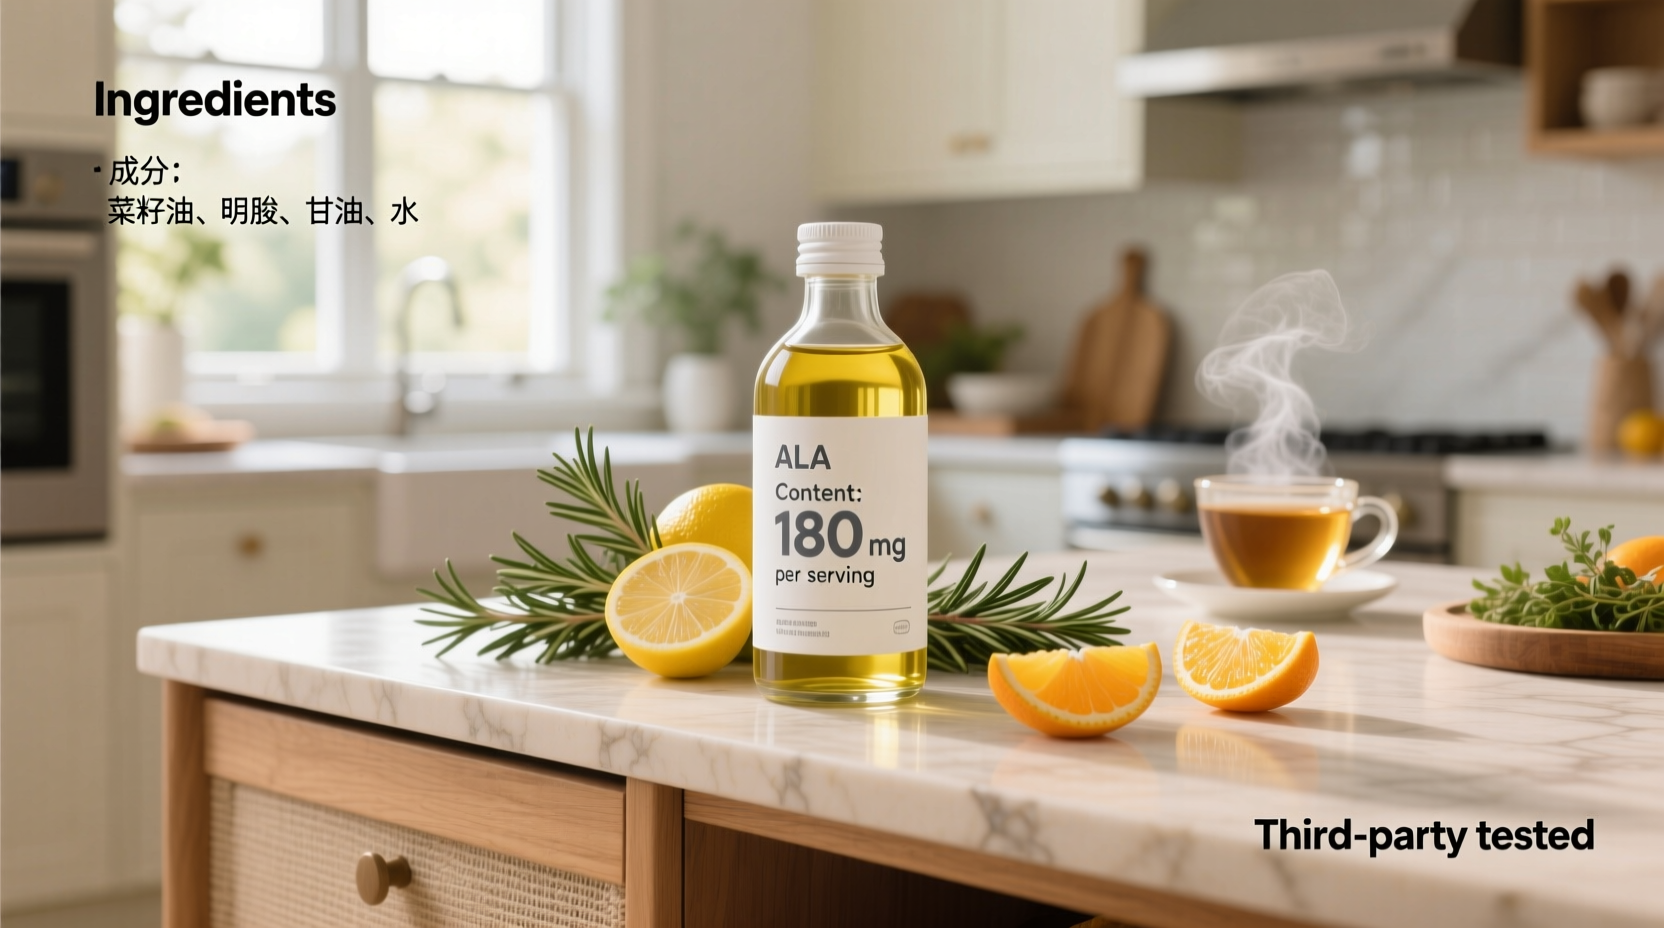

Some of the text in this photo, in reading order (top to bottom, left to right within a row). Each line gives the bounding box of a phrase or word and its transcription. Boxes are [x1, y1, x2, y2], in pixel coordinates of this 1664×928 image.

[774, 444, 832, 470] ALA
[775, 482, 862, 503] Content:
[774, 509, 906, 563] 180 mg
[775, 565, 875, 588] per serving
